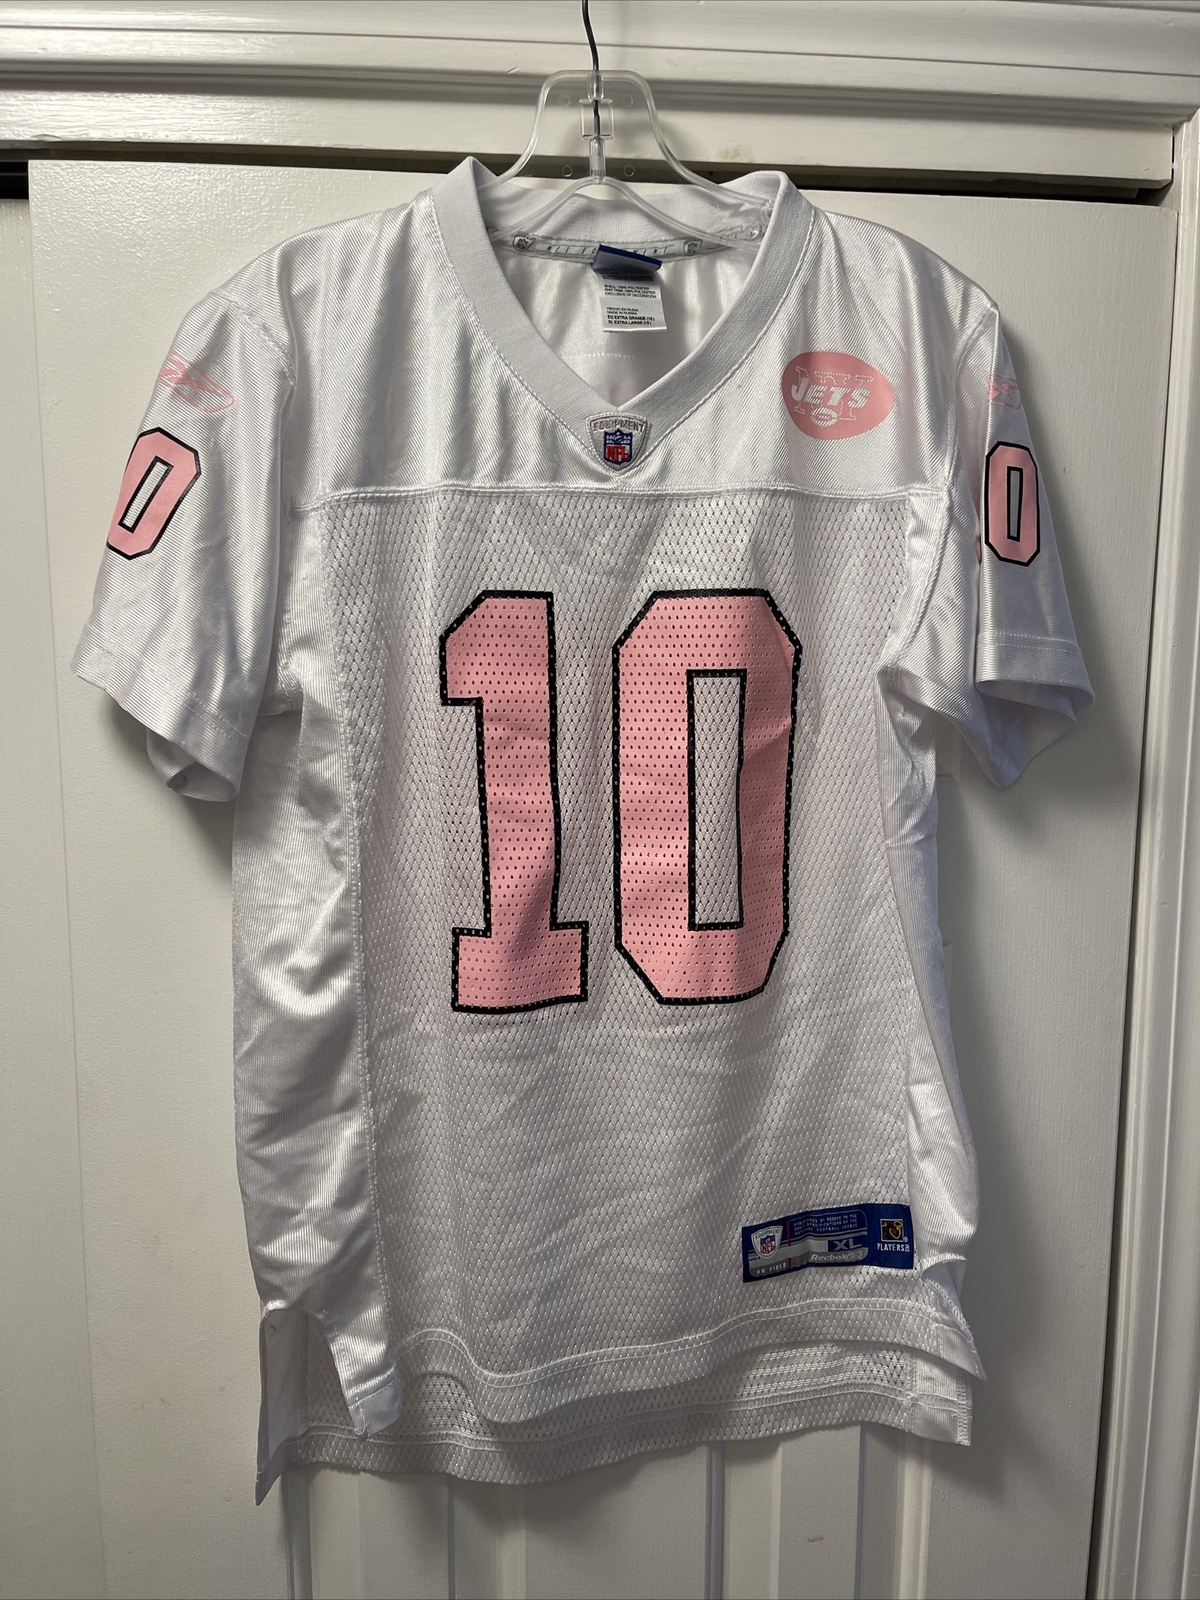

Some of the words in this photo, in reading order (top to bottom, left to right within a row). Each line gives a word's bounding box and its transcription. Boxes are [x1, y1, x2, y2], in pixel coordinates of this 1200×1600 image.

[791, 377, 871, 409] JETS
[592, 419, 644, 432] EQUIPMENT
[605, 445, 631, 462] NFL
[439, 588, 802, 1014] 10
[762, 1241, 776, 1254] NFL
[833, 1238, 862, 1252] XL
[876, 1243, 904, 1252] PLAYERS
[810, 1253, 848, 1261] Reebok
[769, 1262, 787, 1272] FIELD
